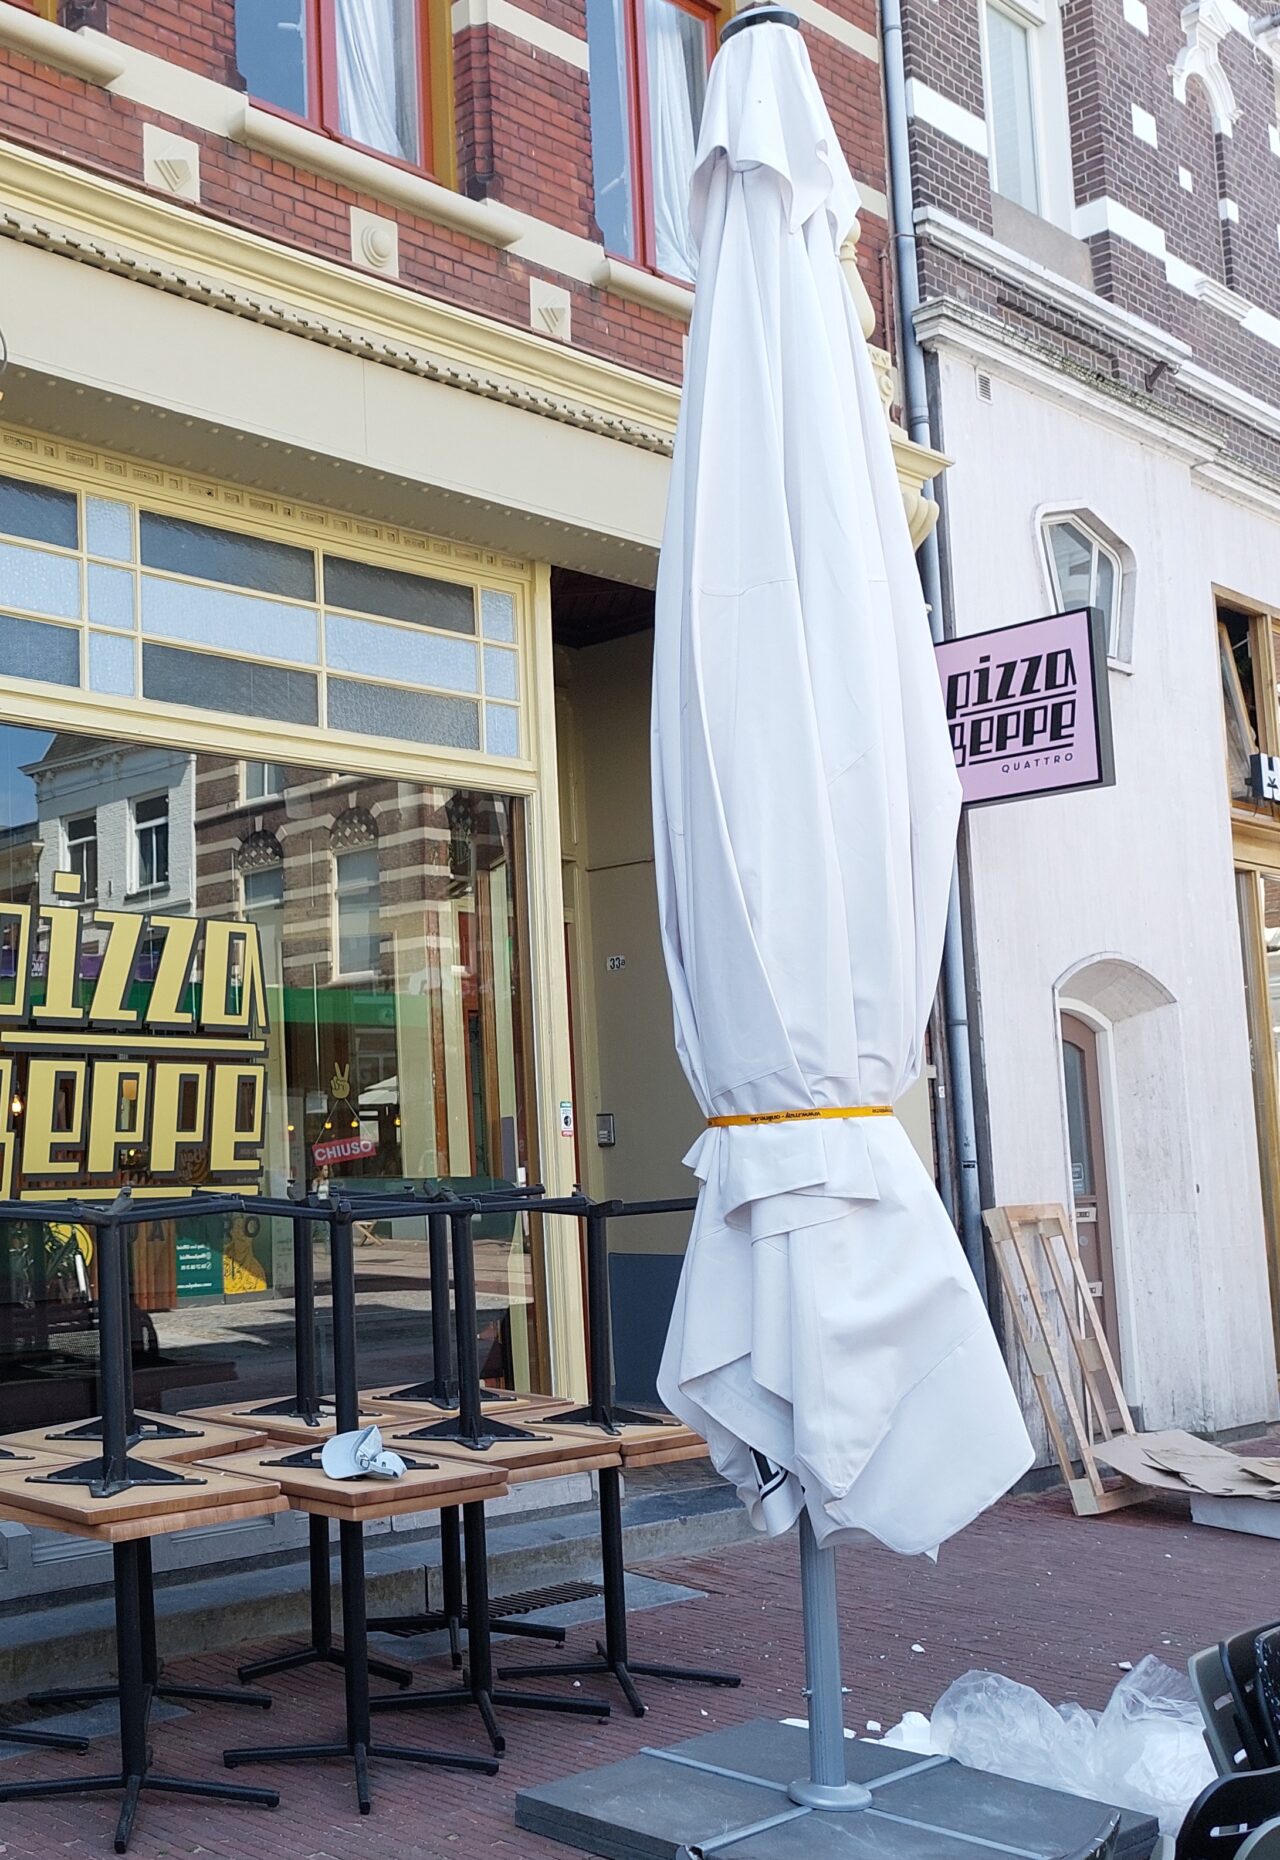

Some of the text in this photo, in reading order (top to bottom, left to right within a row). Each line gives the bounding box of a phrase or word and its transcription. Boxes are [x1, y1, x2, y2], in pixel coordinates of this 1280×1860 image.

[946, 648, 1077, 720] pizza
[1001, 752, 1074, 774] QUATTRO
[609, 956, 625, 970] 33a
[314, 1141, 372, 1160] CHIUSO
